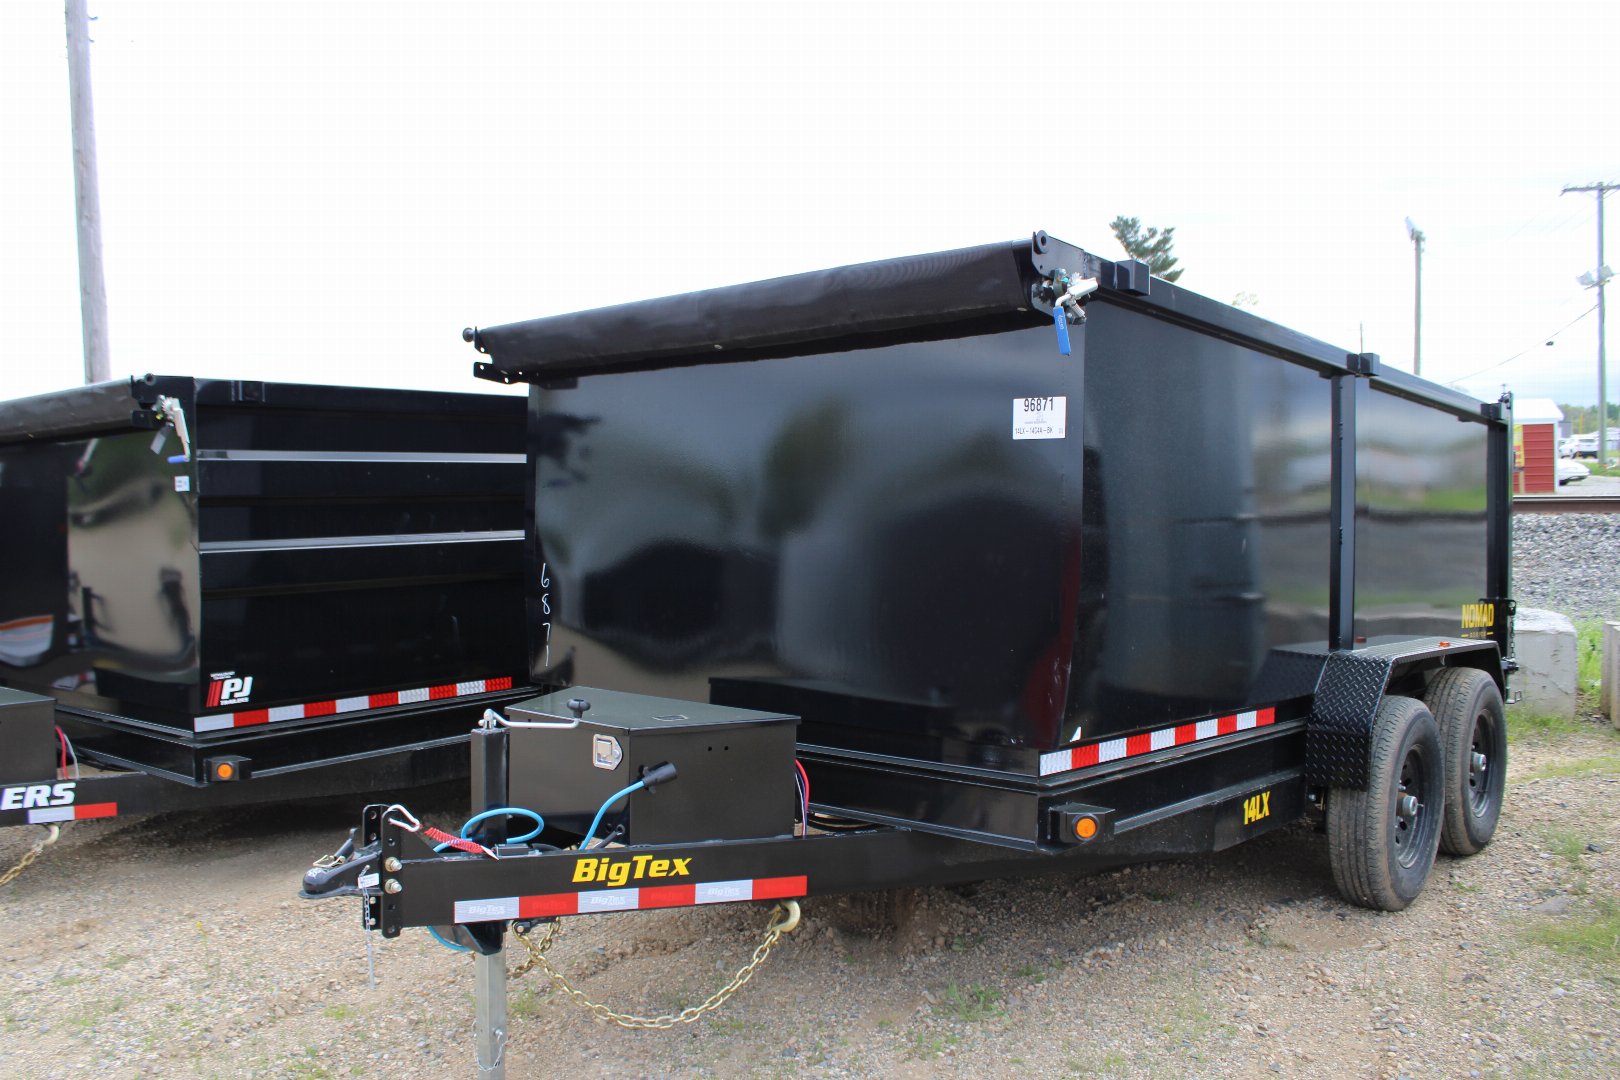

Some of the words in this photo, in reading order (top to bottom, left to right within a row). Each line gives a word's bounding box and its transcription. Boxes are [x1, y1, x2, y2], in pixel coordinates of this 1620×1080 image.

[1023, 397, 1054, 412] 96871
[540, 562, 551, 667] 6871
[1461, 603, 1494, 628] NOMAD
[221, 676, 253, 700] PJ
[0, 782, 77, 810] ERS
[1243, 791, 1270, 825] 14LX
[572, 855, 692, 887] BigTex
